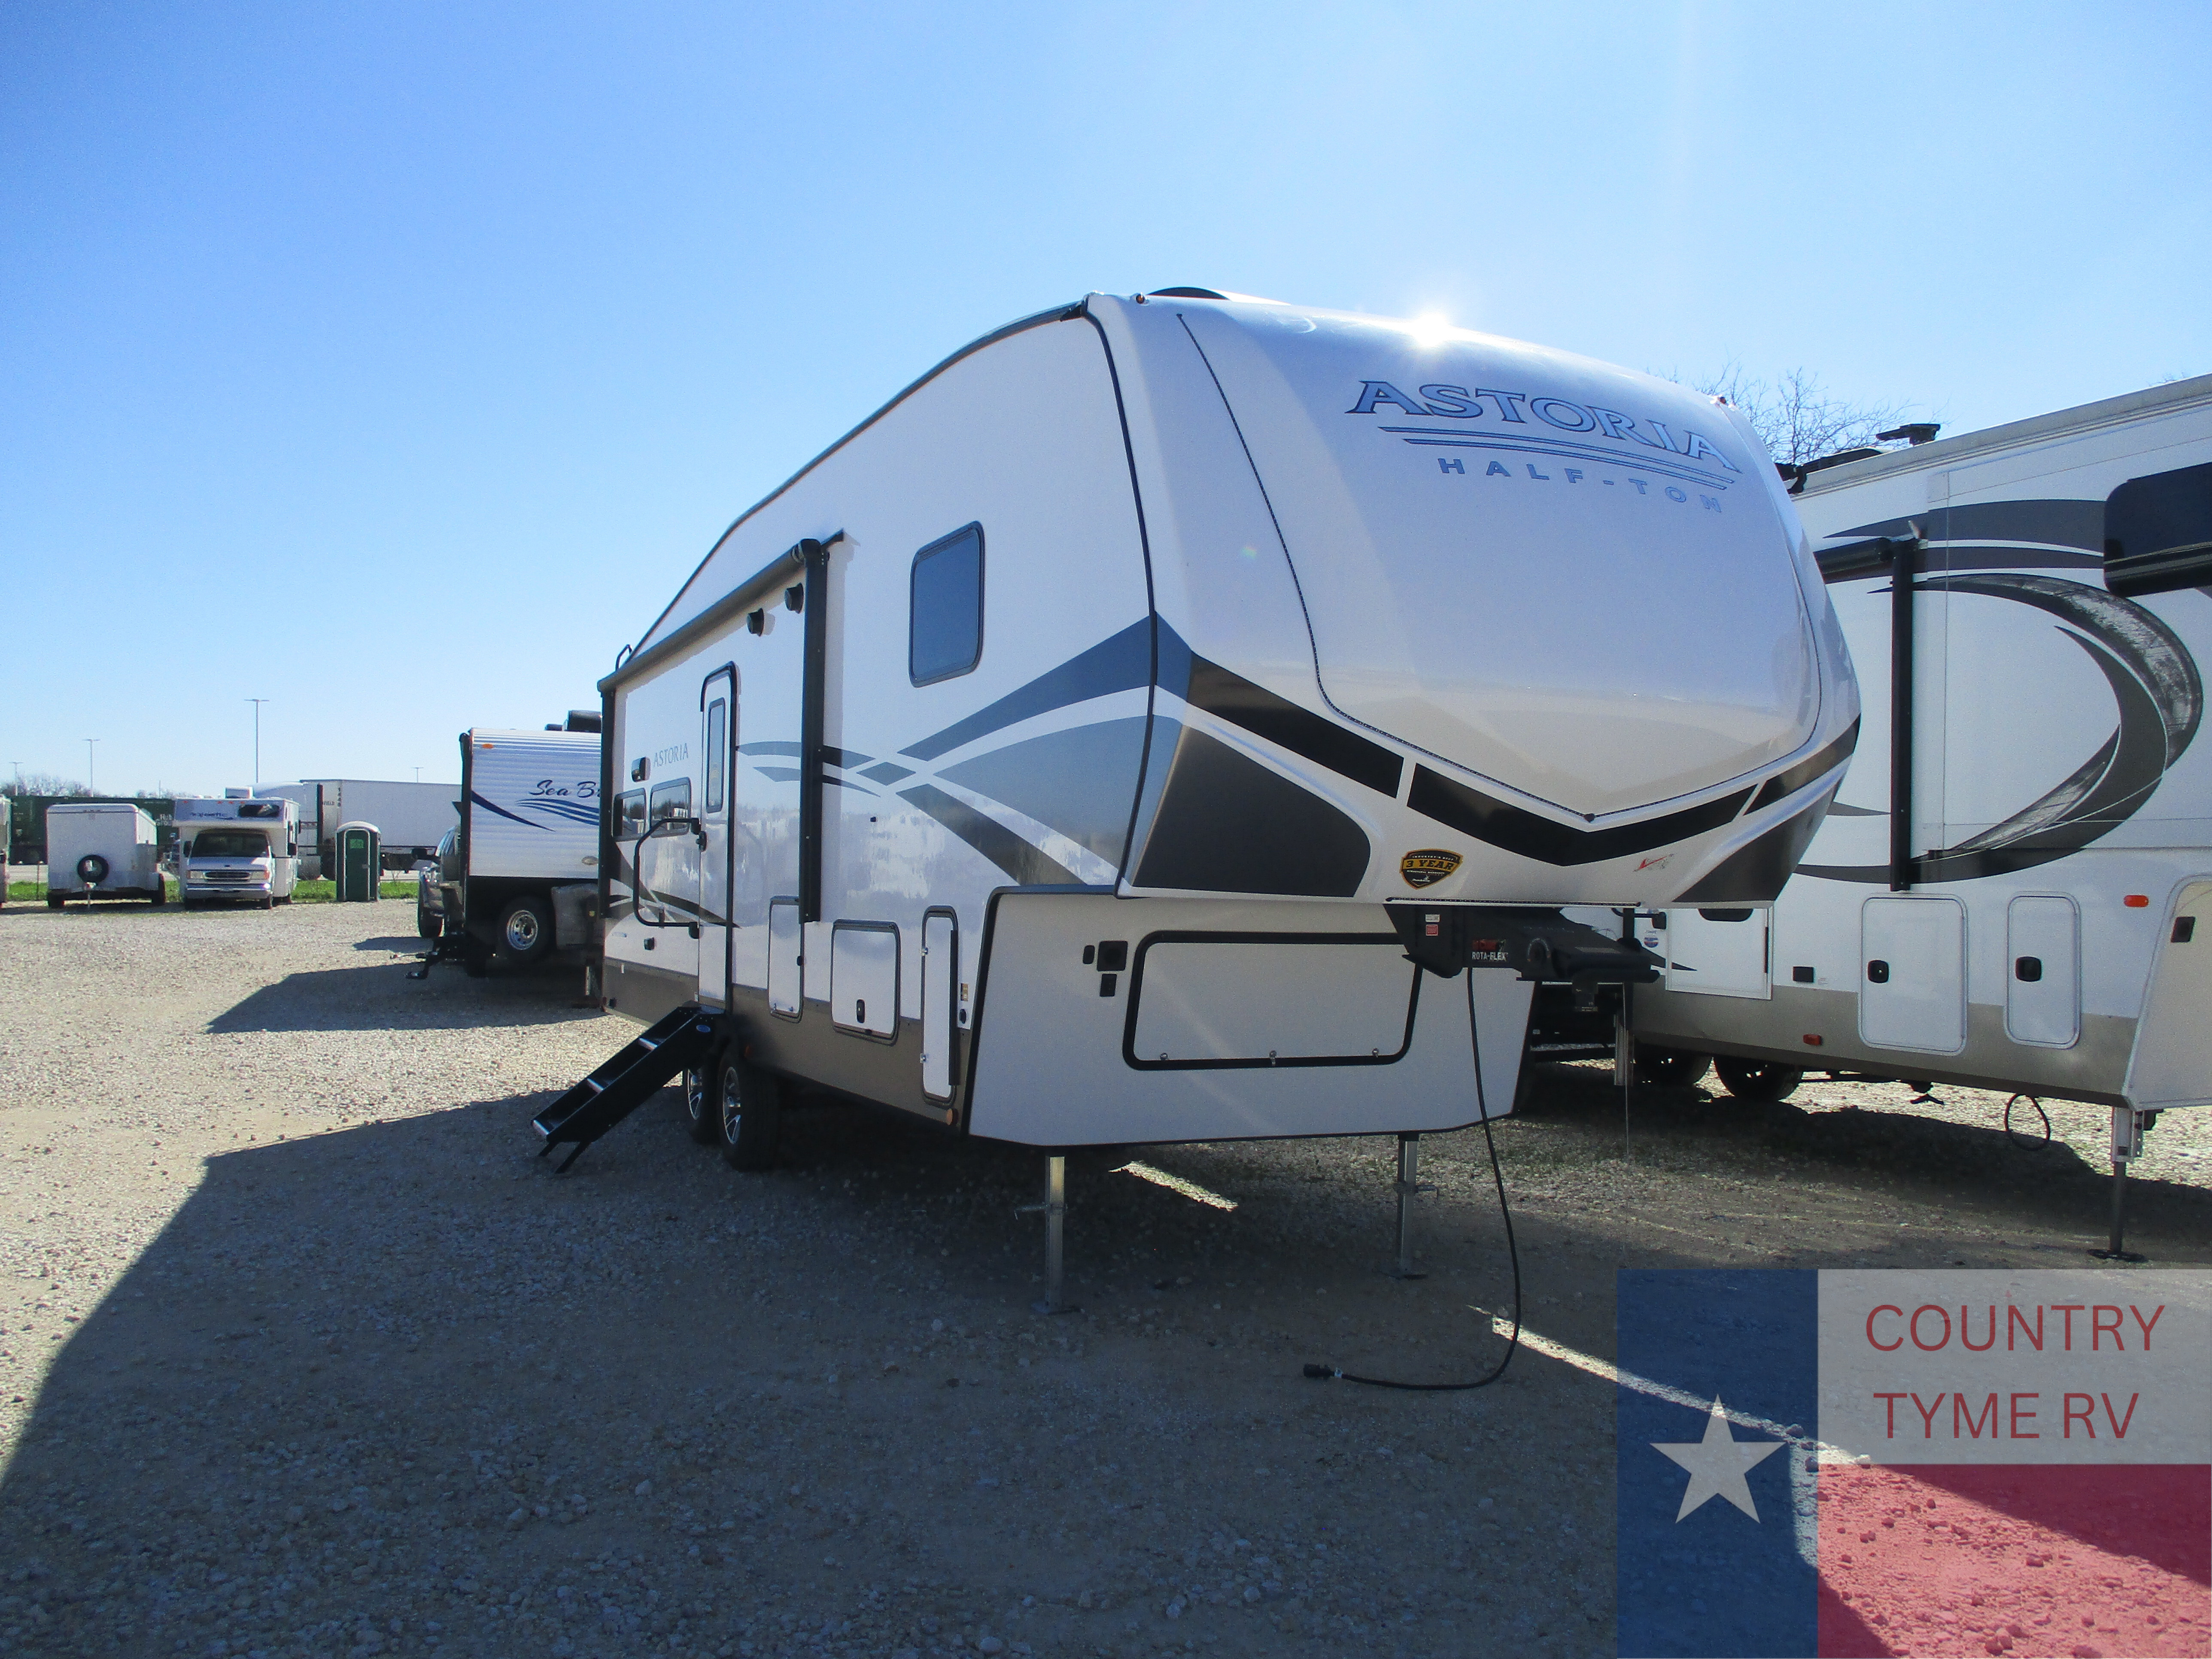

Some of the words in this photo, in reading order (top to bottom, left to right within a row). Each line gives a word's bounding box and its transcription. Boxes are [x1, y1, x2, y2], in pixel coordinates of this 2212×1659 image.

[1345, 380, 1742, 474] ASTORIA
[1437, 458, 1722, 513] HALF-TON
[653, 743, 689, 767] ASTORIA
[528, 779, 571, 796] Sea
[1419, 860, 1454, 870] YEAR
